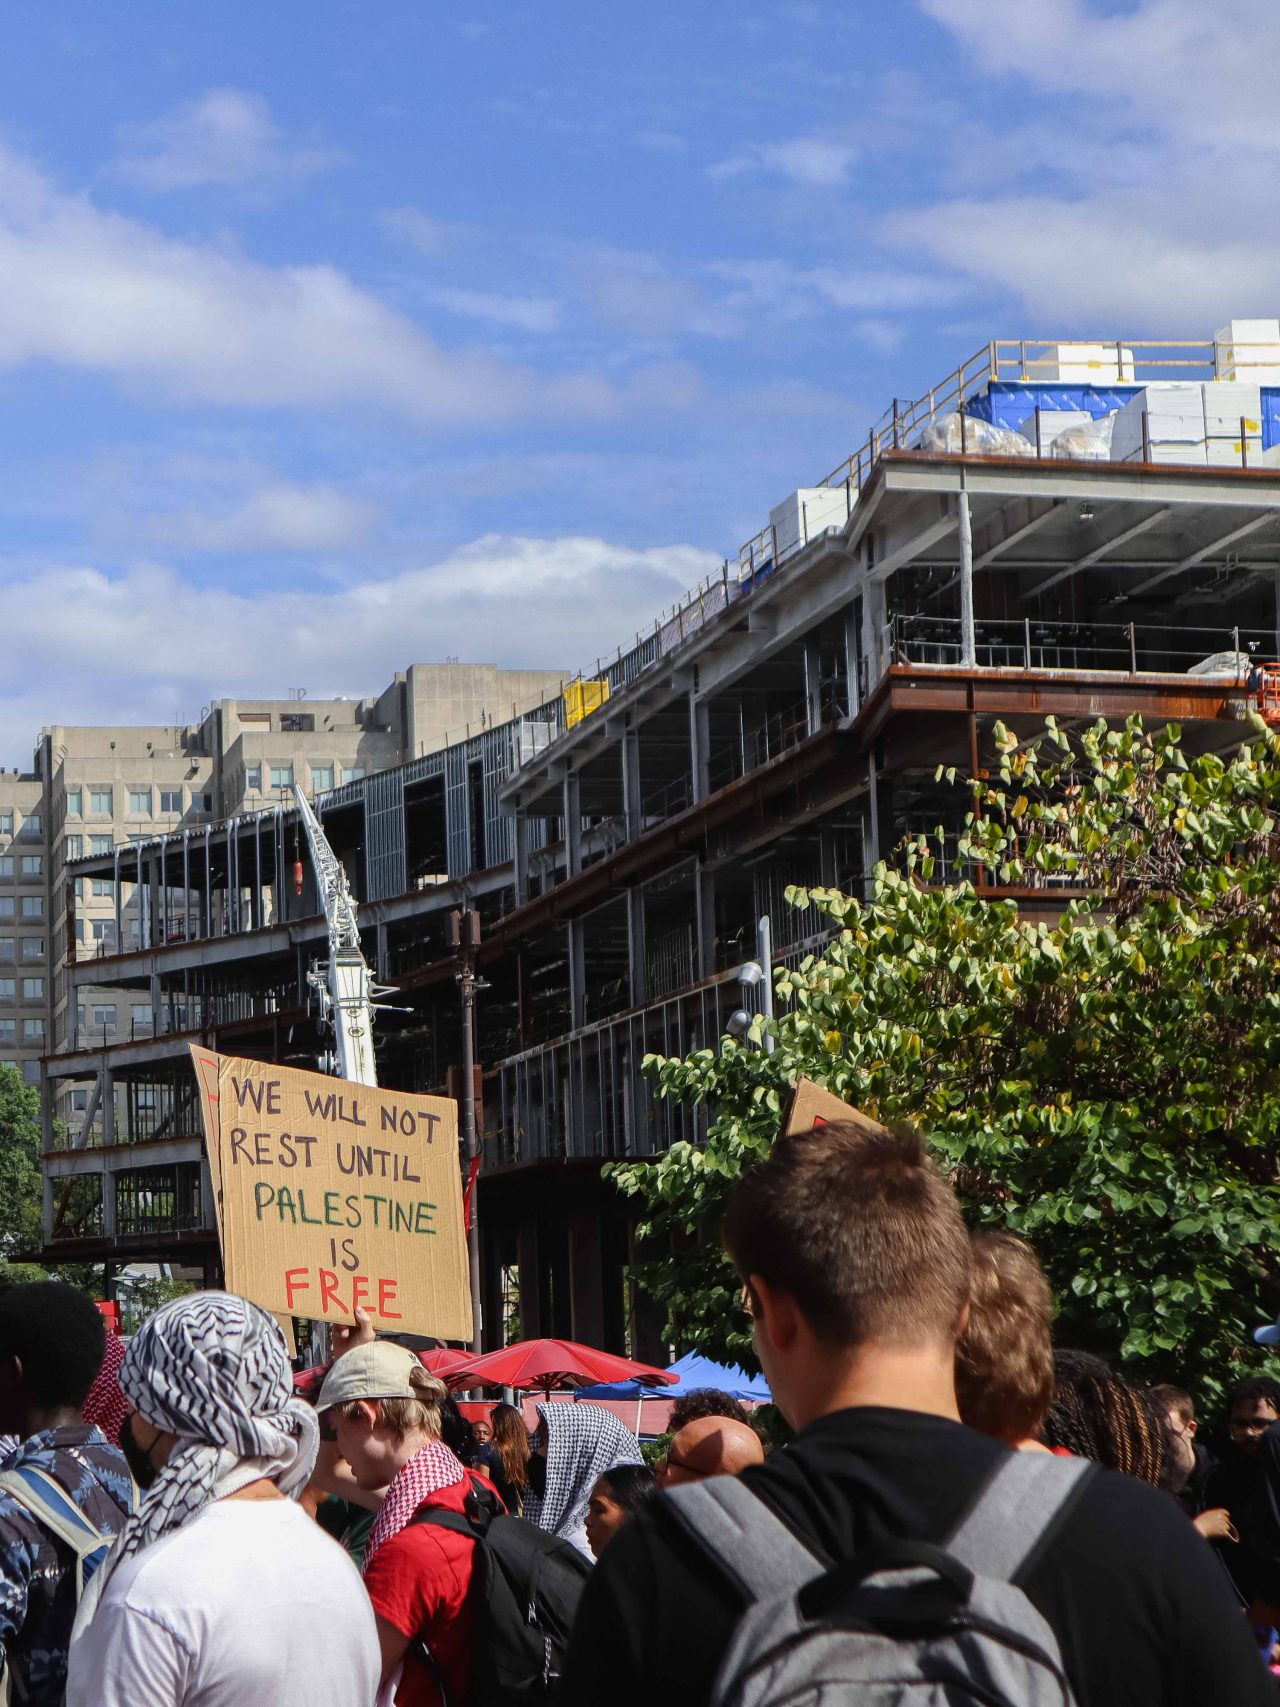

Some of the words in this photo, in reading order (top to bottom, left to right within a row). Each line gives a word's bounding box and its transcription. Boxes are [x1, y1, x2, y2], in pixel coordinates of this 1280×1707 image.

[231, 1076, 281, 1115] WE
[304, 1089, 367, 1127] WILL
[380, 1105, 441, 1144] NOT
[230, 1127, 318, 1167] REST
[336, 1143, 421, 1183] UNTIL
[254, 1181, 438, 1235] PALESTINE
[331, 1237, 360, 1272] IS
[284, 1267, 402, 1319] FREE
